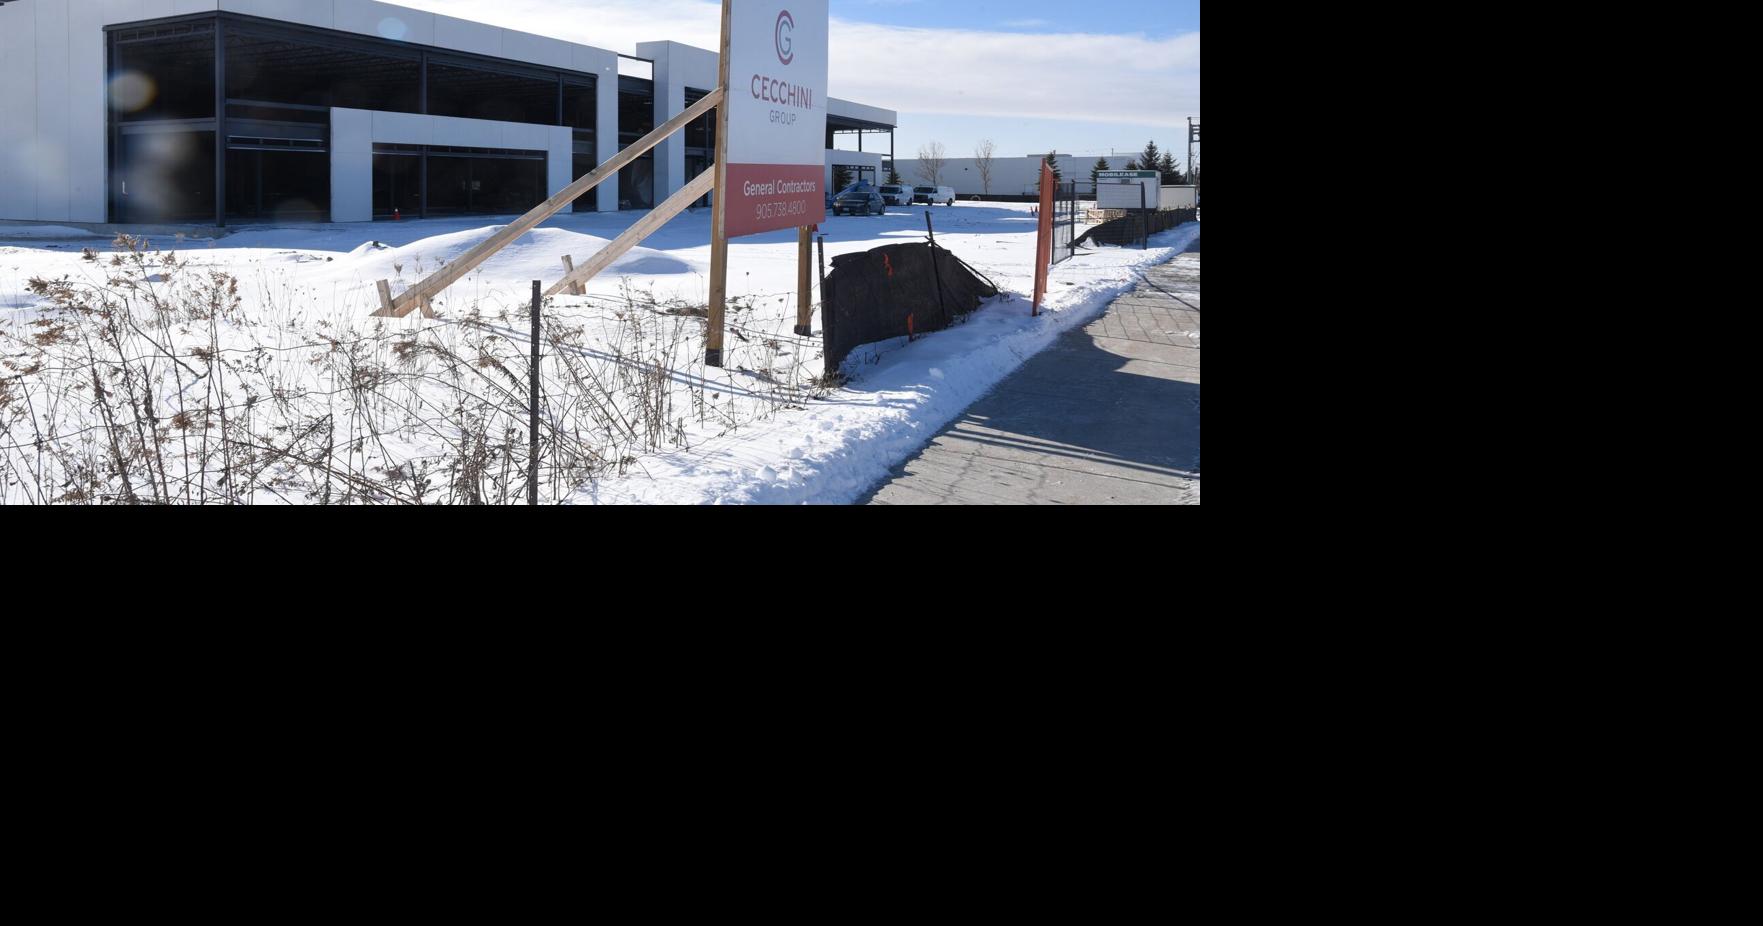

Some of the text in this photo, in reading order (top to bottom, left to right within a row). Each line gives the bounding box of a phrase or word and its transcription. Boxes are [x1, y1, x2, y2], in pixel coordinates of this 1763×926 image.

[751, 74, 812, 110] CECCHINI
[770, 110, 796, 125] GROUP
[743, 178, 816, 196] General Contractors
[756, 200, 806, 220] 905.738.4800
